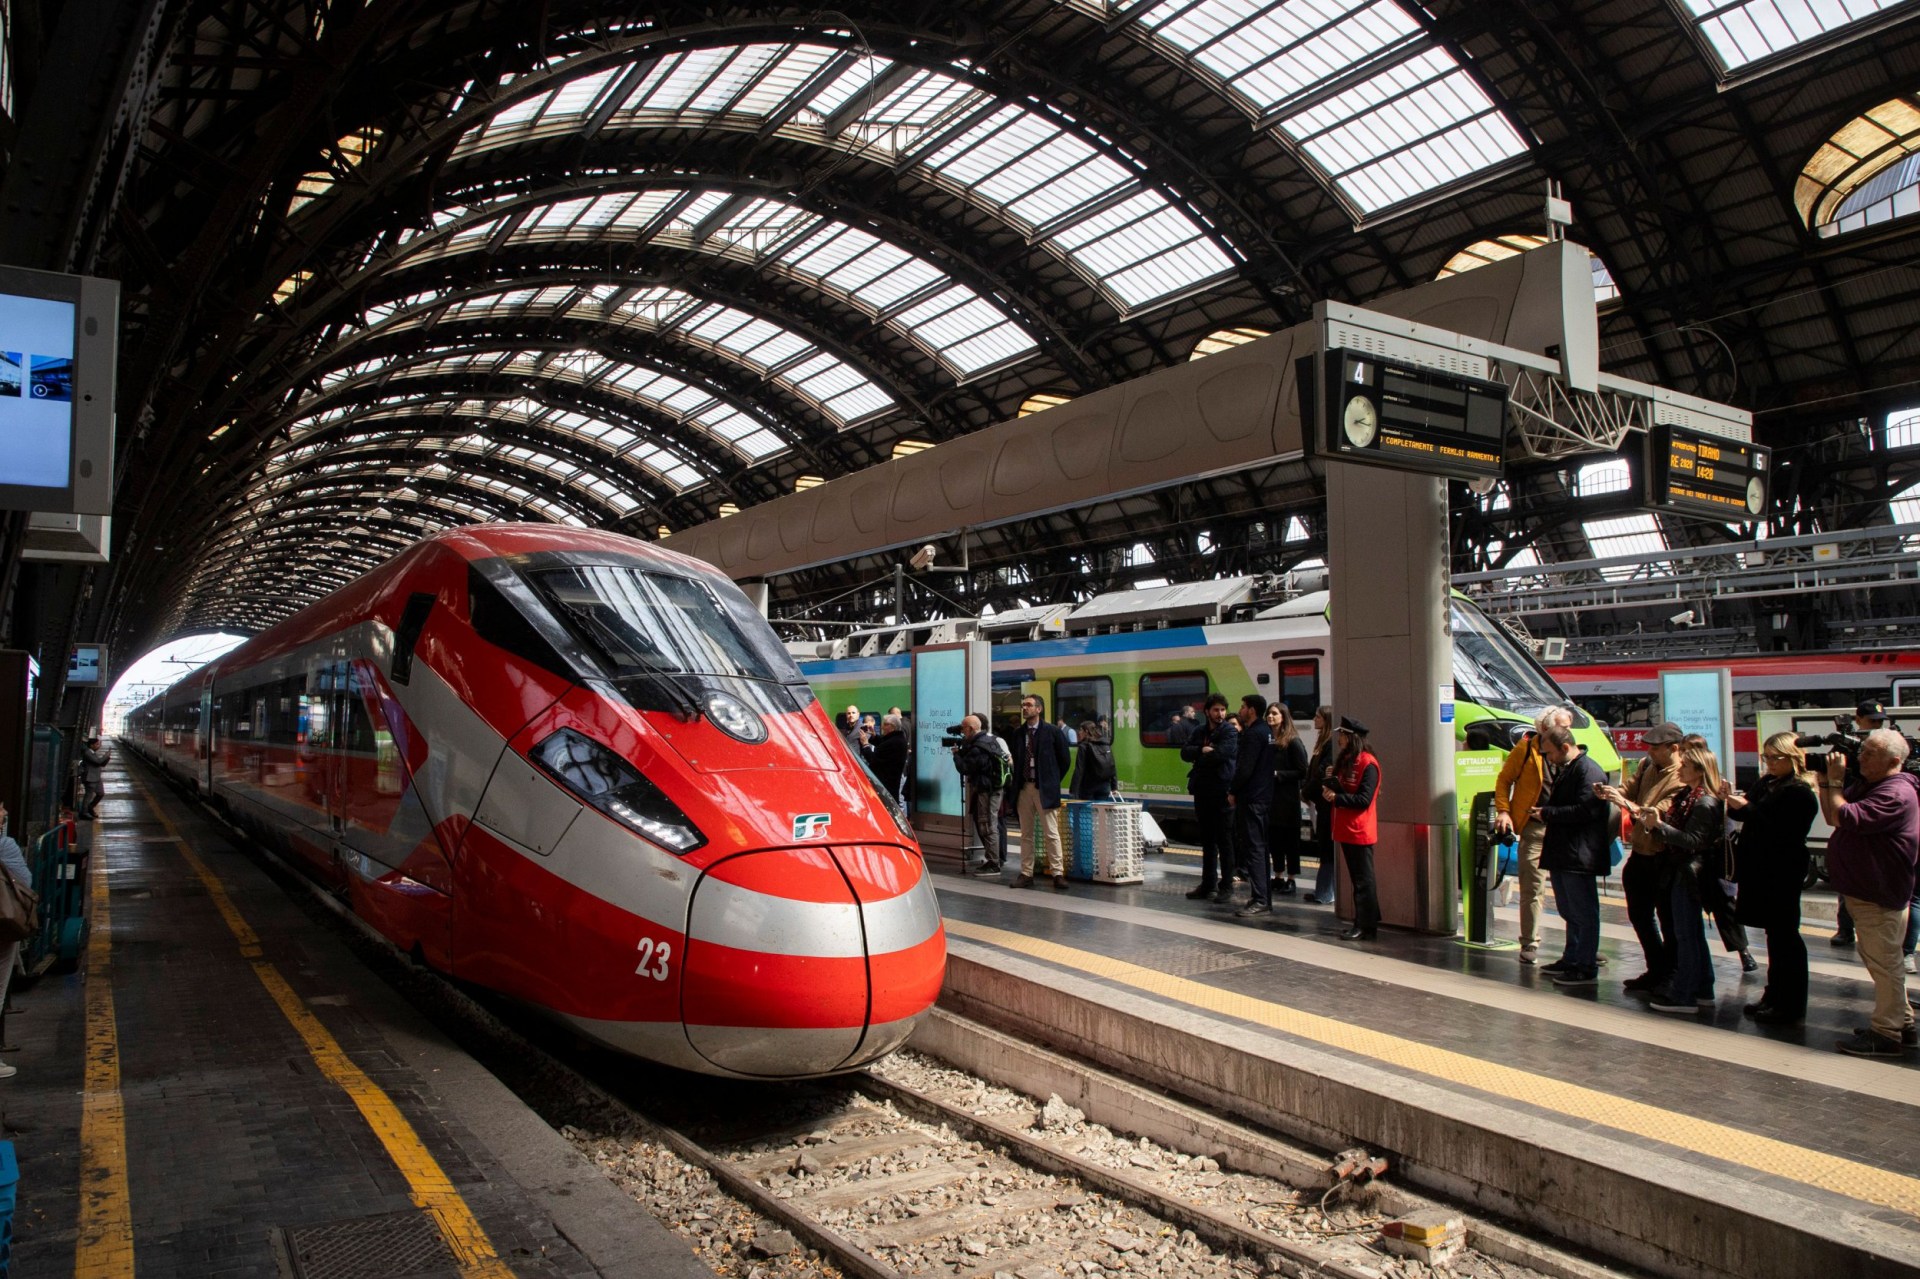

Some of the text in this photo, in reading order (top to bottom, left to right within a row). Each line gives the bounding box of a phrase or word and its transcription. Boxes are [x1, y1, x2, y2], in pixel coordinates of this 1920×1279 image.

[1354, 362, 1364, 384] 4
[1385, 436, 1434, 452] COMPLETAMENTE
[1698, 444, 1720, 461] TIRANO
[1756, 453, 1763, 470] 5
[929, 708, 939, 717] Join
[946, 708, 952, 716] at
[932, 721, 949, 731] Design
[1457, 757, 1486, 765] GETTALO
[635, 937, 671, 981] 23
